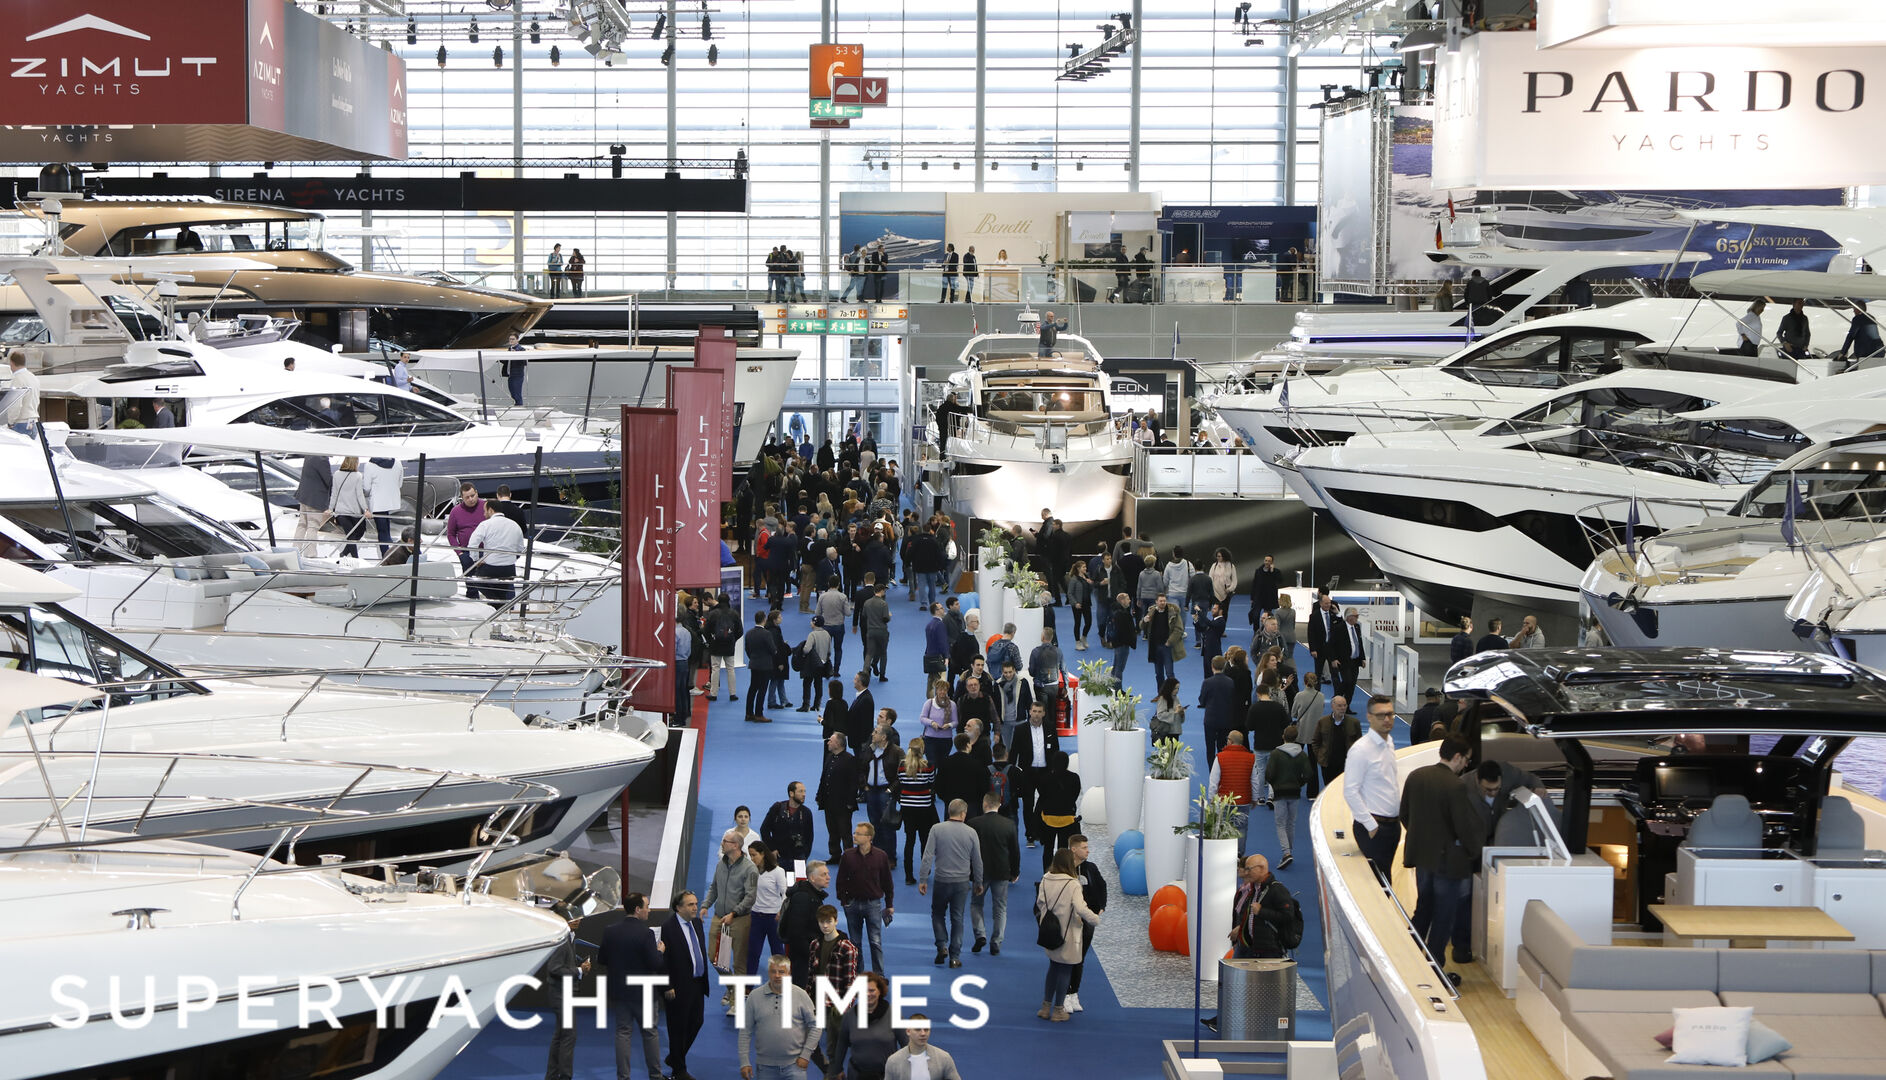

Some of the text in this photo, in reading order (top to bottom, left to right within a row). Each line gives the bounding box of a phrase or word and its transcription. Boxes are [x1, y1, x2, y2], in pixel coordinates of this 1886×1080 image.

[835, 46, 848, 55] 5-3
[39, 84, 141, 96] YACHTS
[1521, 68, 1866, 113] PARDO
[41, 134, 113, 142] YACHTS
[1612, 133, 1772, 151] YACHTS
[215, 188, 405, 201] SIRENA YACHTS
[968, 212, 1033, 234] Benetti
[1753, 237, 1810, 246] SKYDECK
[1754, 257, 1789, 266] Winning
[698, 416, 709, 542] AZIMUT
[654, 473, 665, 648] AZIMUT
